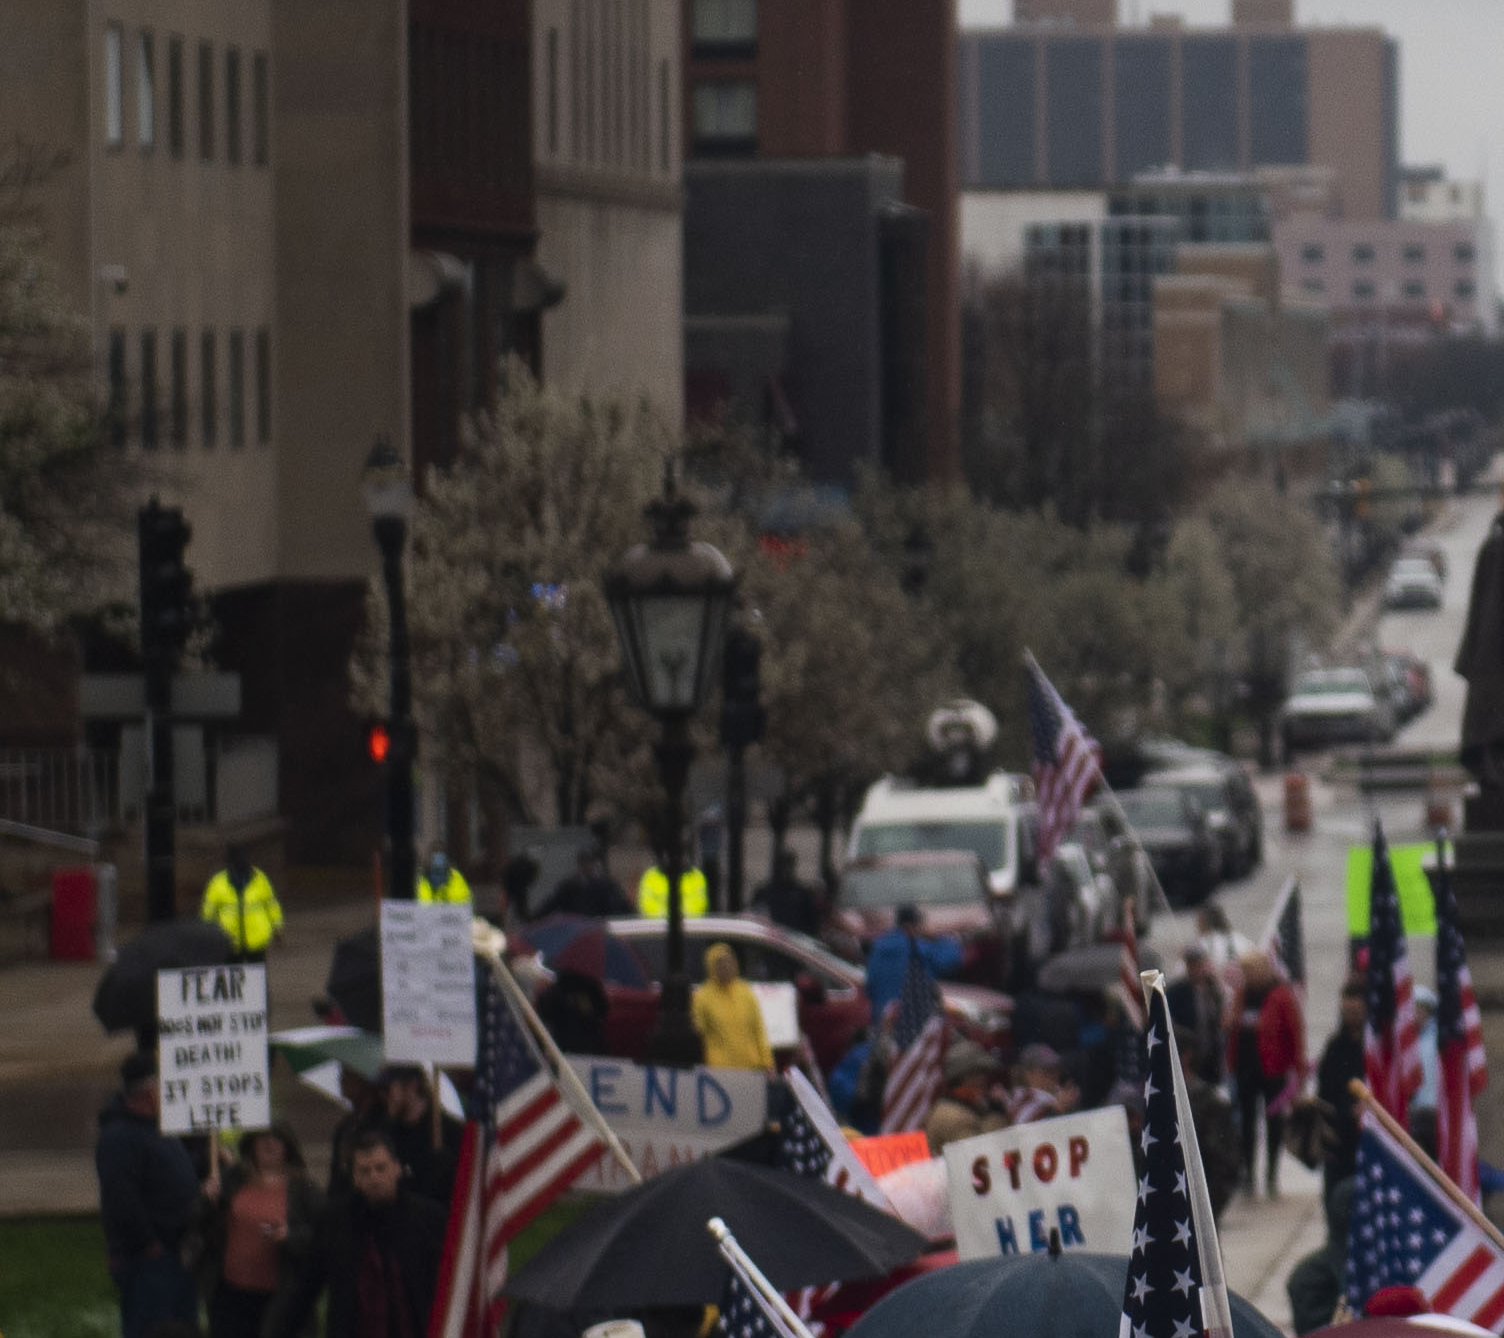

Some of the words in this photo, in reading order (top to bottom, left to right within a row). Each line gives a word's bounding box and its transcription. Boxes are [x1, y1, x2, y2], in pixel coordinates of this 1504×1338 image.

[182, 967, 244, 1002] FEAR
[591, 1064, 733, 1127] END
[971, 1134, 1090, 1196] STOP
[994, 1204, 1086, 1256] HER
